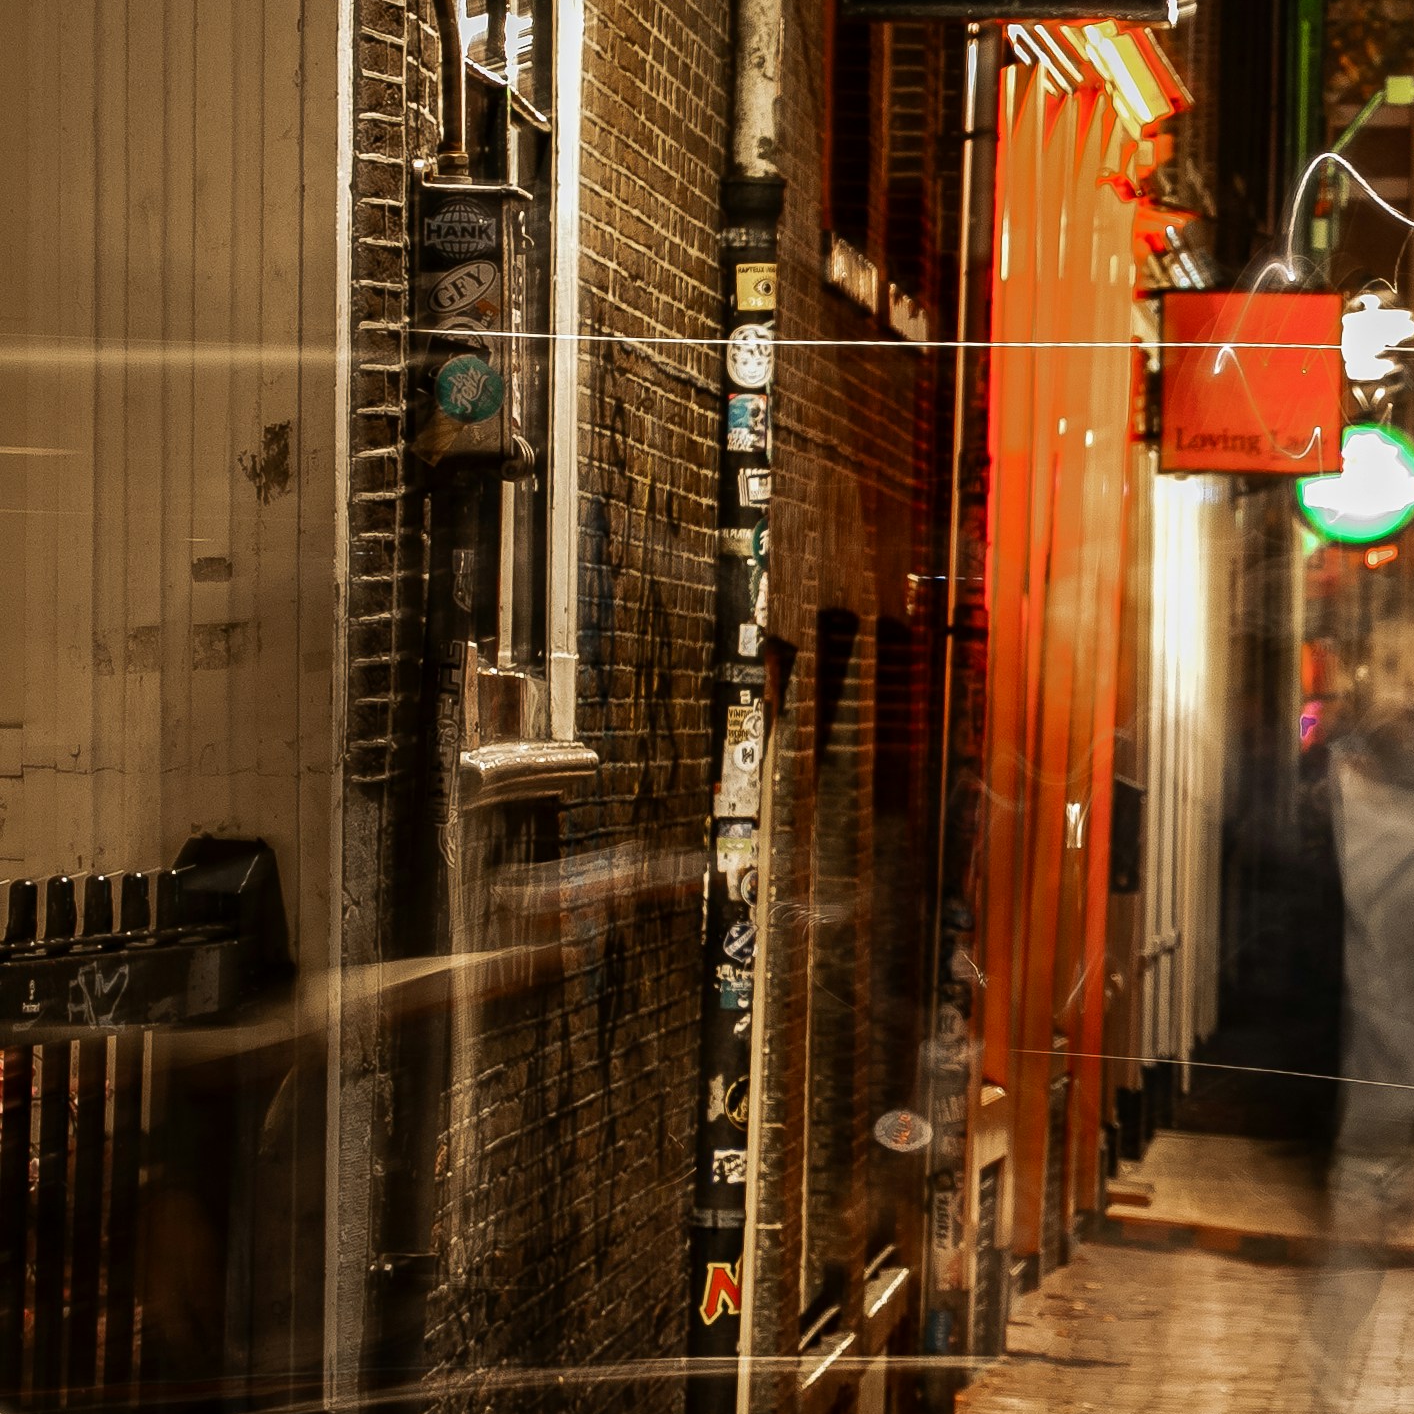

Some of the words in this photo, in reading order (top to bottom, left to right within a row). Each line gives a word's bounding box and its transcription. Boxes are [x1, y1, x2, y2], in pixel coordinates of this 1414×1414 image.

[426, 223, 494, 243] HANK
[433, 265, 487, 309] GFY
[1175, 427, 1262, 457] Loving
